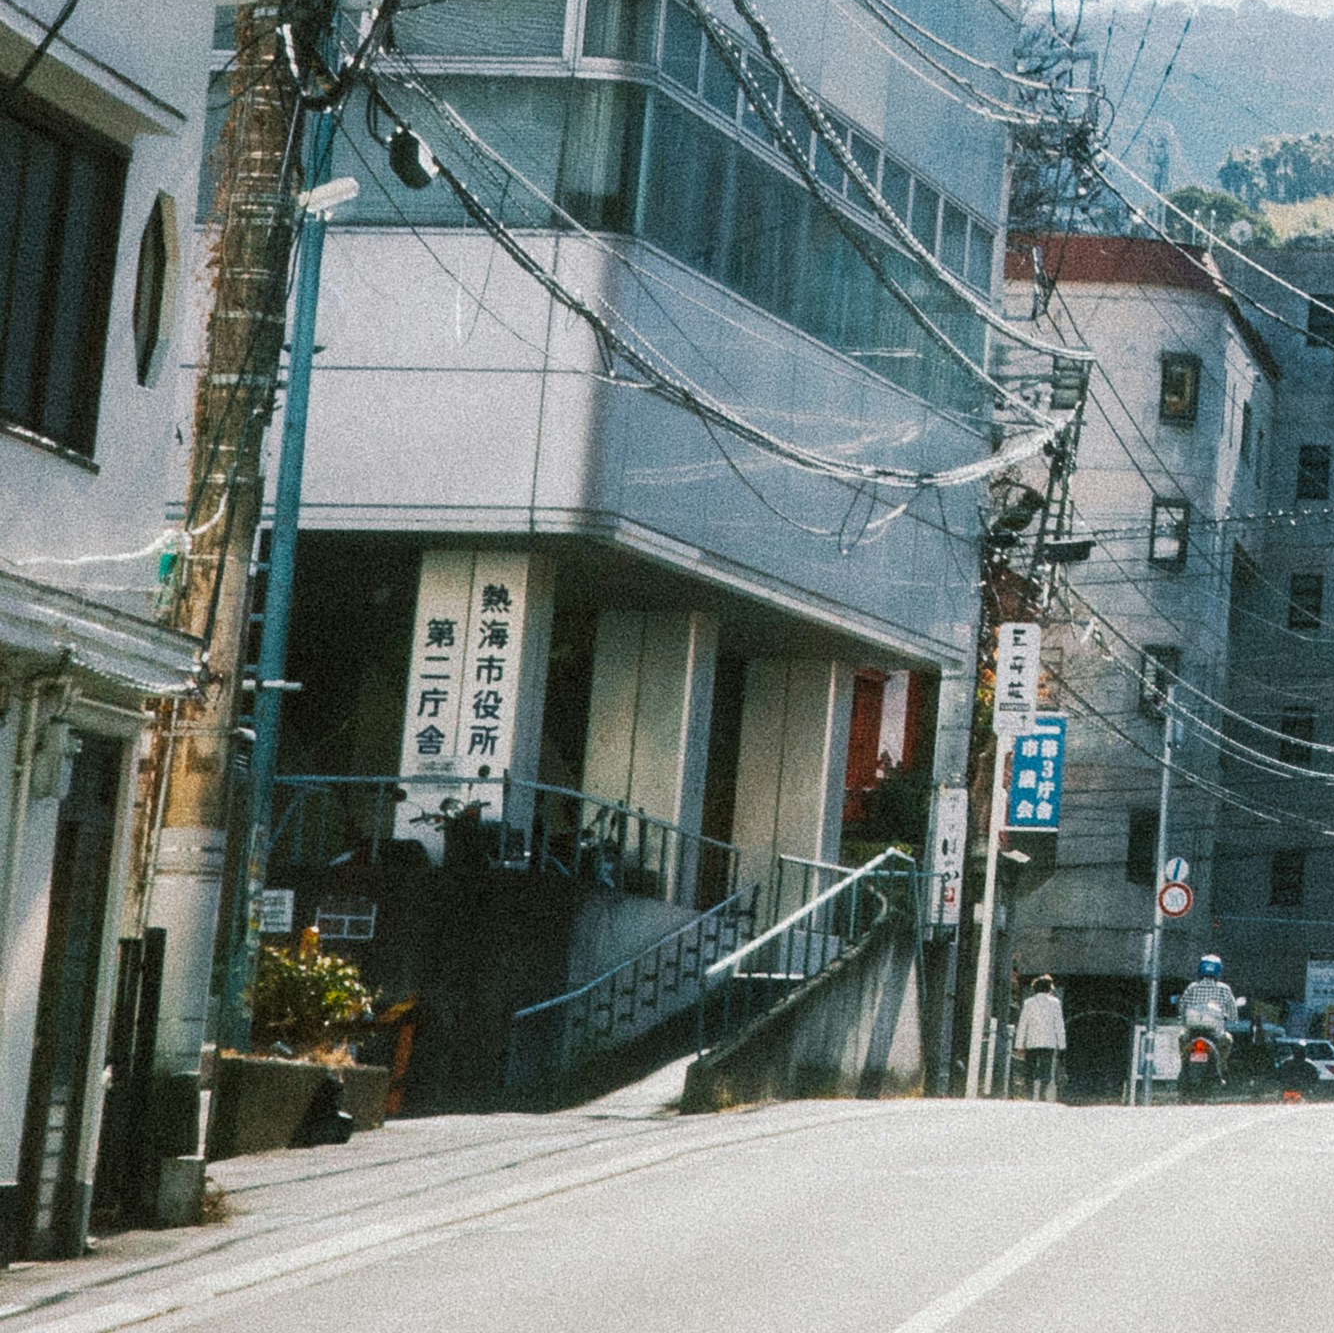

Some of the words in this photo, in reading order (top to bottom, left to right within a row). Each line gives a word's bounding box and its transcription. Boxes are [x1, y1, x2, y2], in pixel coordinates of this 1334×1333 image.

[415, 617, 457, 756] 第二庁舎
[467, 583, 512, 756] 熱海市役所
